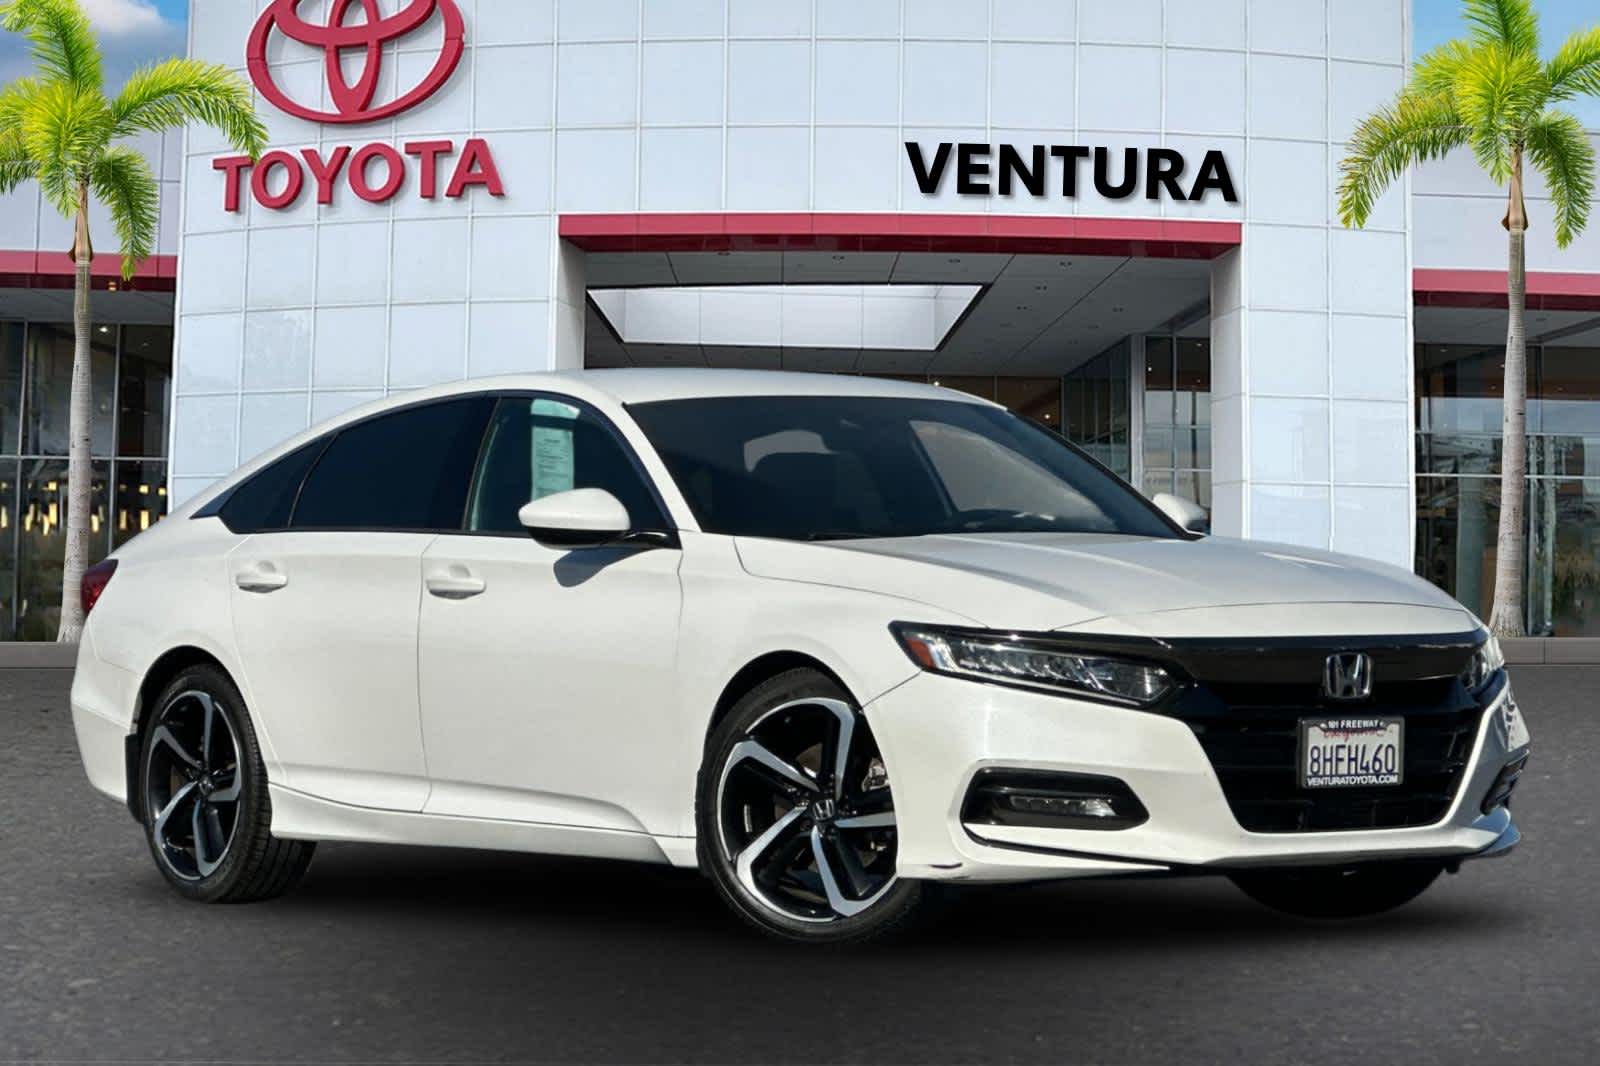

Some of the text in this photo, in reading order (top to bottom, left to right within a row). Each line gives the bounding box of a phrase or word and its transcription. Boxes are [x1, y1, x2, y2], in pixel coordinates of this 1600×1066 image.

[213, 138, 504, 212] TOYOTA
[905, 142, 1238, 203] VENTURA
[1340, 720, 1379, 729] FREEWAY
[1310, 744, 1396, 776] 8HFH460
[1307, 774, 1399, 786] VENTURATOYOTA.COM
